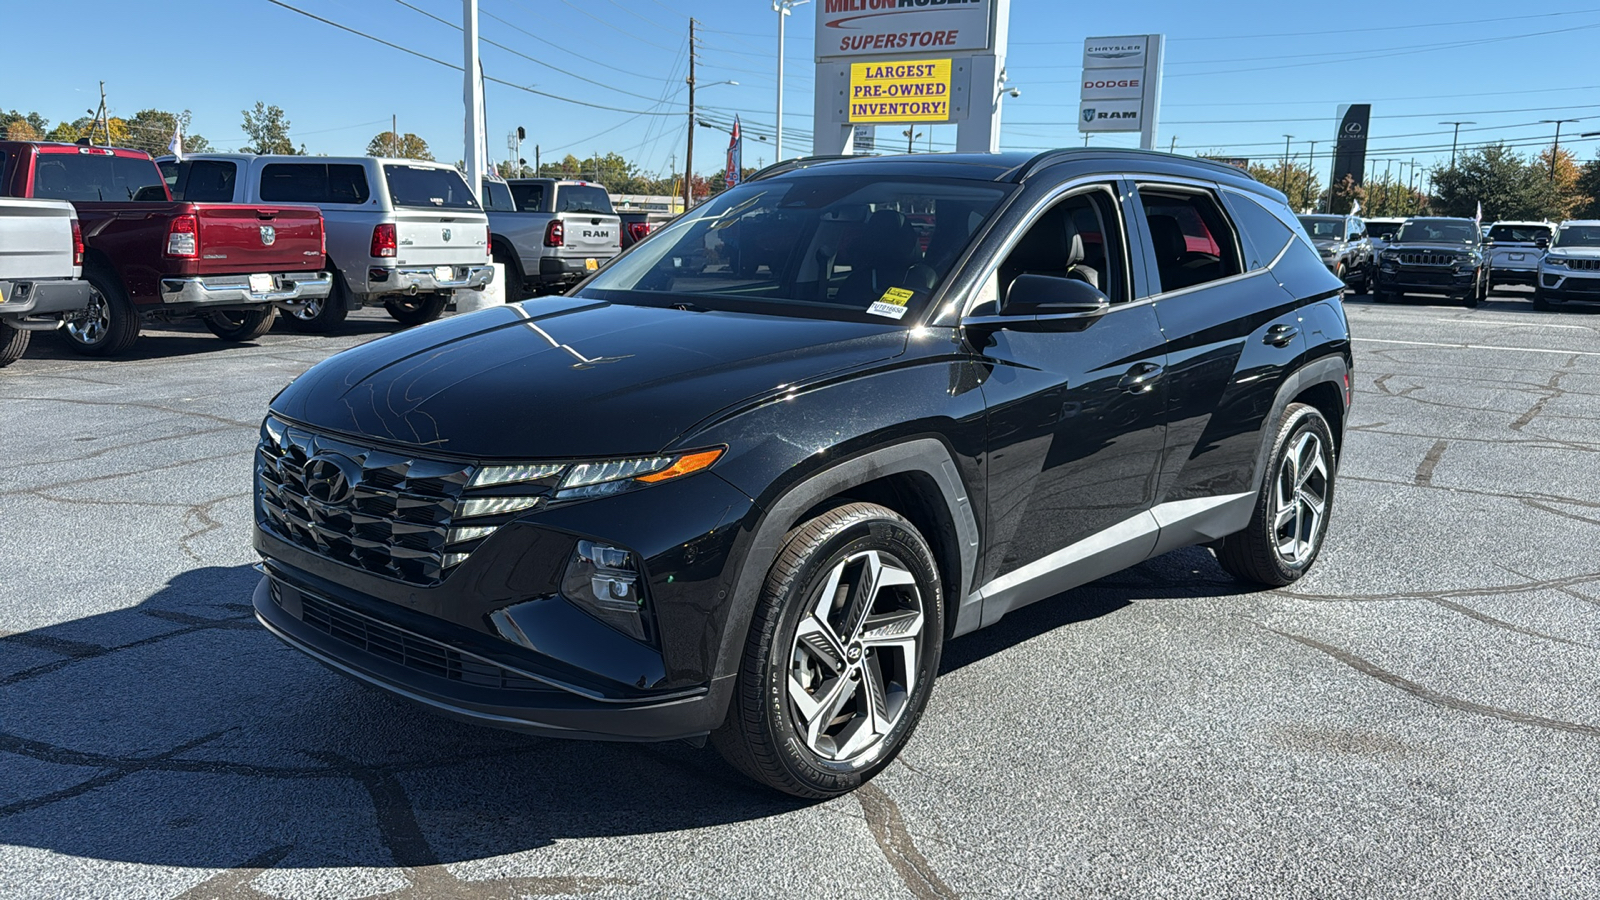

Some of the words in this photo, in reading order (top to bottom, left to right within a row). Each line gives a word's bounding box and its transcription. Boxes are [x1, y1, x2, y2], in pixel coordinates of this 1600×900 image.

[839, 30, 959, 51] SUPERSTORE
[1087, 45, 1141, 53] CHRYSLER
[865, 64, 936, 79] LARGEST
[853, 82, 946, 97] PRE-OWNED
[1084, 80, 1140, 89] DODGE
[851, 101, 947, 116] INVENTORY!
[1097, 111, 1138, 119] RAM
[582, 230, 609, 238] RAM
